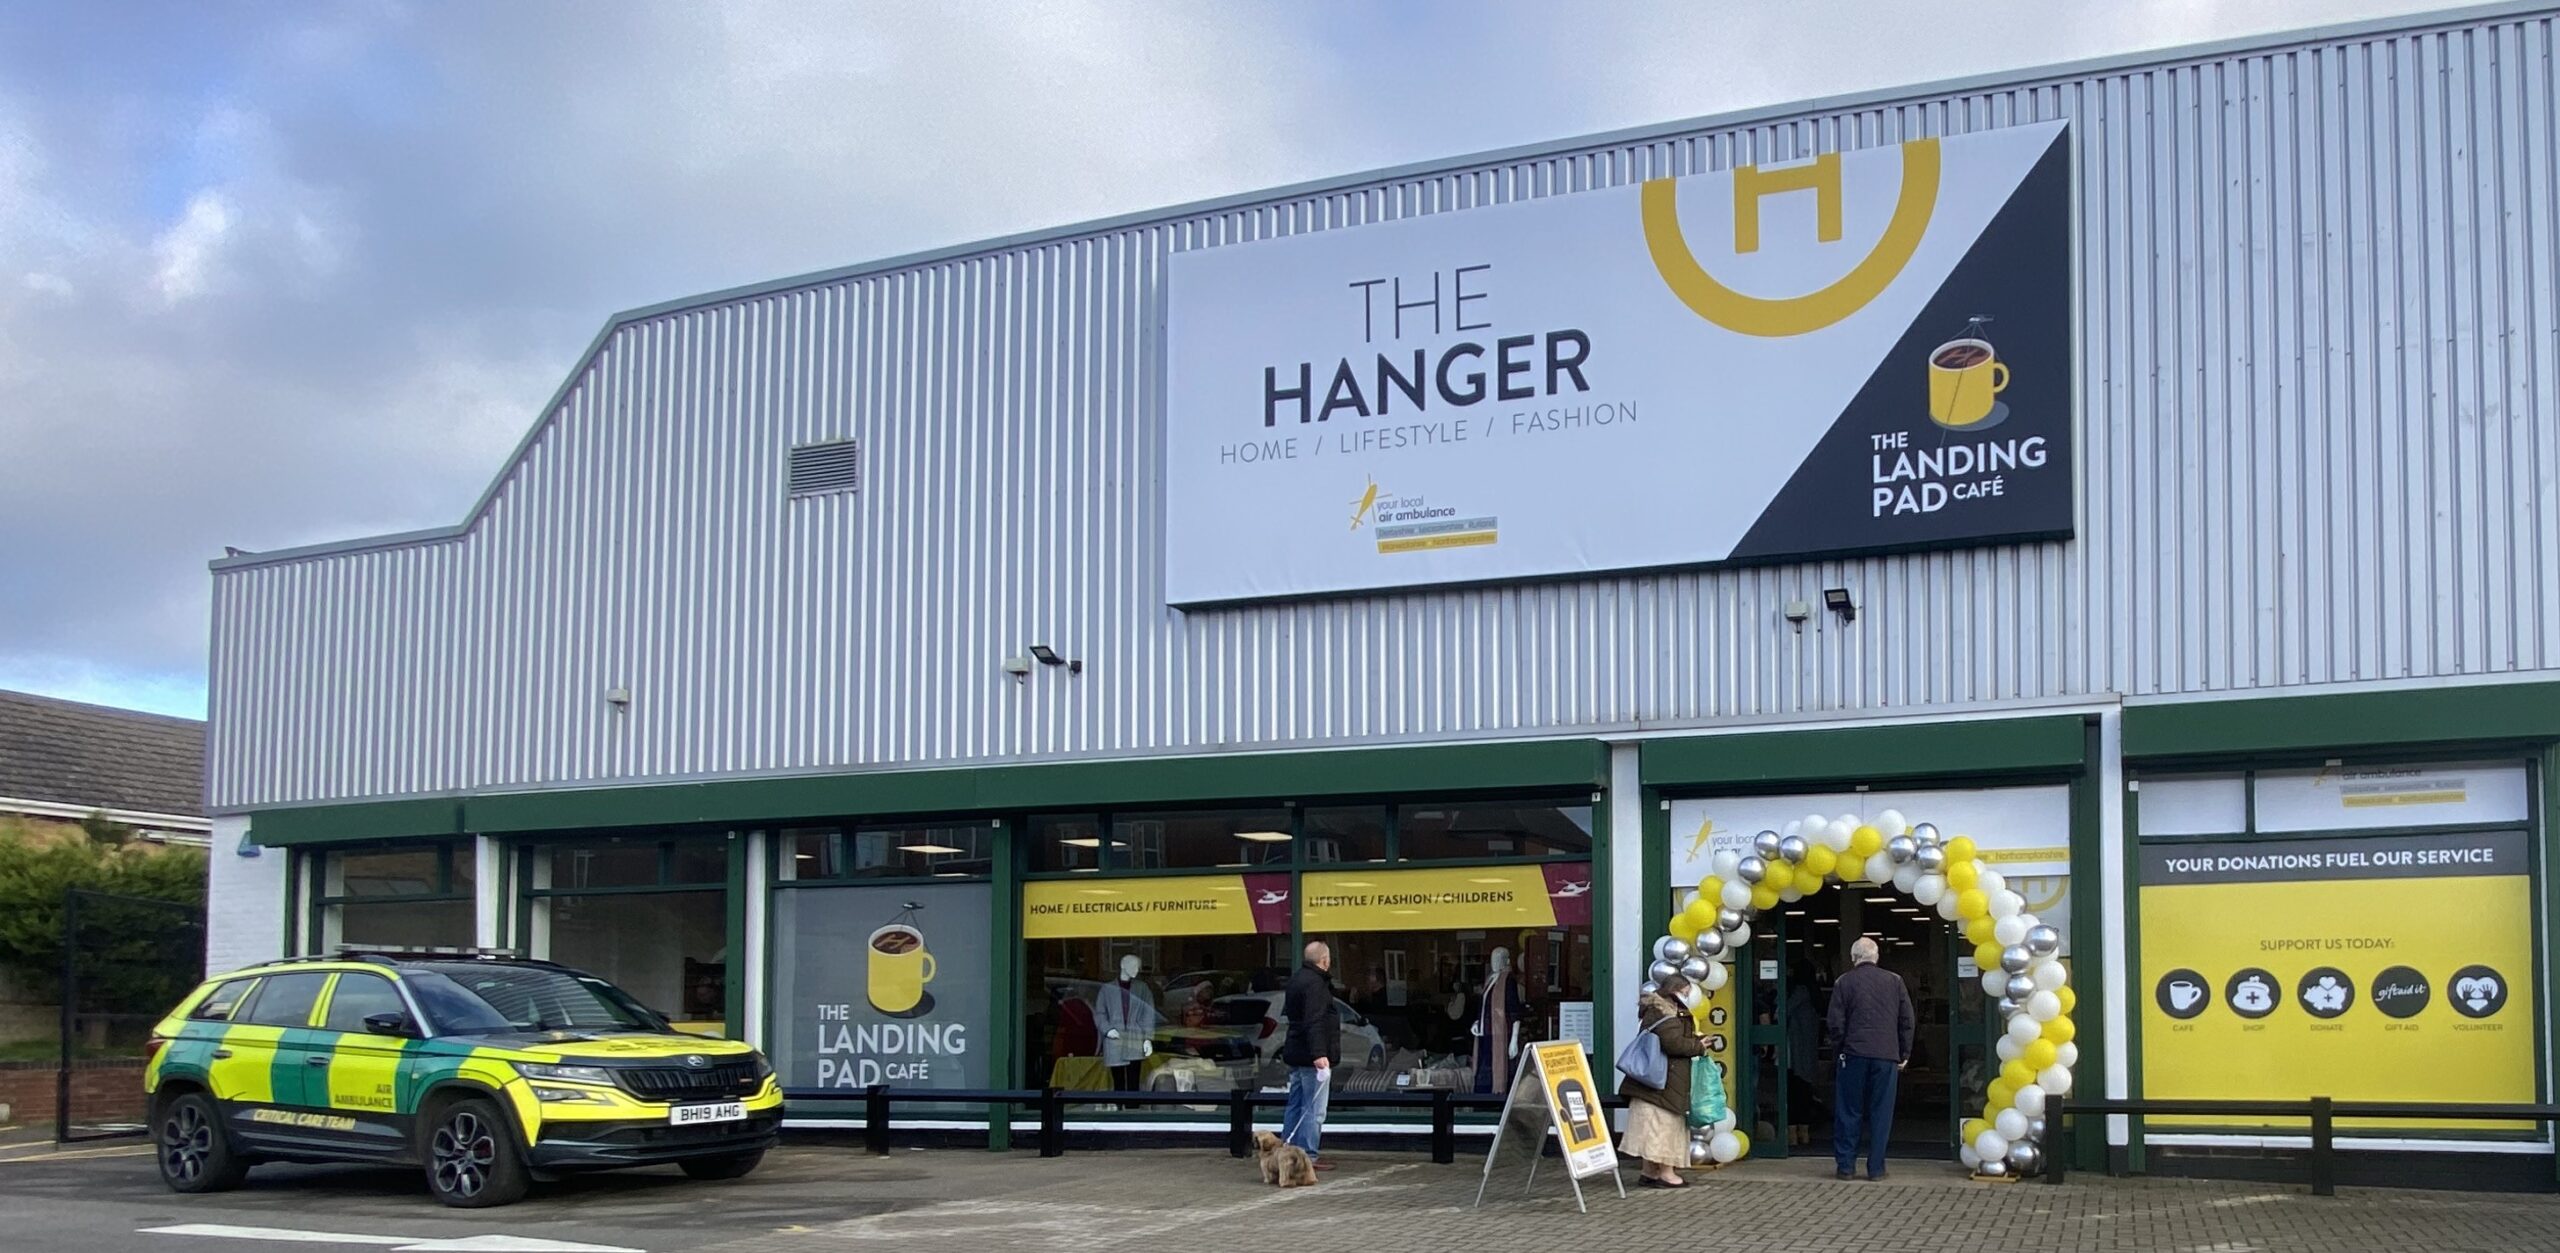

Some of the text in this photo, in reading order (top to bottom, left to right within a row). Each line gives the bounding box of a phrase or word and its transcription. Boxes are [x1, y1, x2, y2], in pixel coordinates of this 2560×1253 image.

[1349, 263, 1492, 343] THE
[1264, 328, 1592, 428] HANGER
[1221, 437, 1298, 465] HOME
[1340, 420, 1468, 454] LIFESTYLE
[1512, 400, 1638, 435] FASHION
[1871, 431, 1909, 451] THE
[1872, 436, 2048, 484] LANDING
[1376, 495, 1424, 512] your local
[1872, 475, 2005, 518] PAD CAFÉ
[1379, 507, 1456, 523] air ambulance
[2342, 768, 2422, 780] air ambulance
[1712, 836, 1733, 847] your
[2165, 848, 2494, 873] YOUR DONATIONS FUEL OUR SERVICE
[1030, 903, 1063, 914] HOME
[1073, 901, 1143, 913] ELECTRICALS
[1153, 899, 1217, 911] FURNITURE
[1309, 895, 1367, 908] LIFESTYLE
[1378, 893, 1432, 905] FASHION
[1442, 891, 1513, 904] CHILDRENS
[2259, 937, 2395, 951] SUPPORT US TODAY:
[817, 1004, 850, 1020] THE
[2310, 1024, 2344, 1032] DONATE
[2452, 1023, 2504, 1032] VOLUNTEER
[818, 1024, 966, 1055] LANDING
[817, 1059, 929, 1088] PAD CAFÉ
[376, 1084, 393, 1095] AIR
[334, 1094, 393, 1109] AMBULANCE
[254, 1108, 357, 1131] CRITICAL CARE TEAM
[681, 1104, 740, 1121] BH19 AHG
